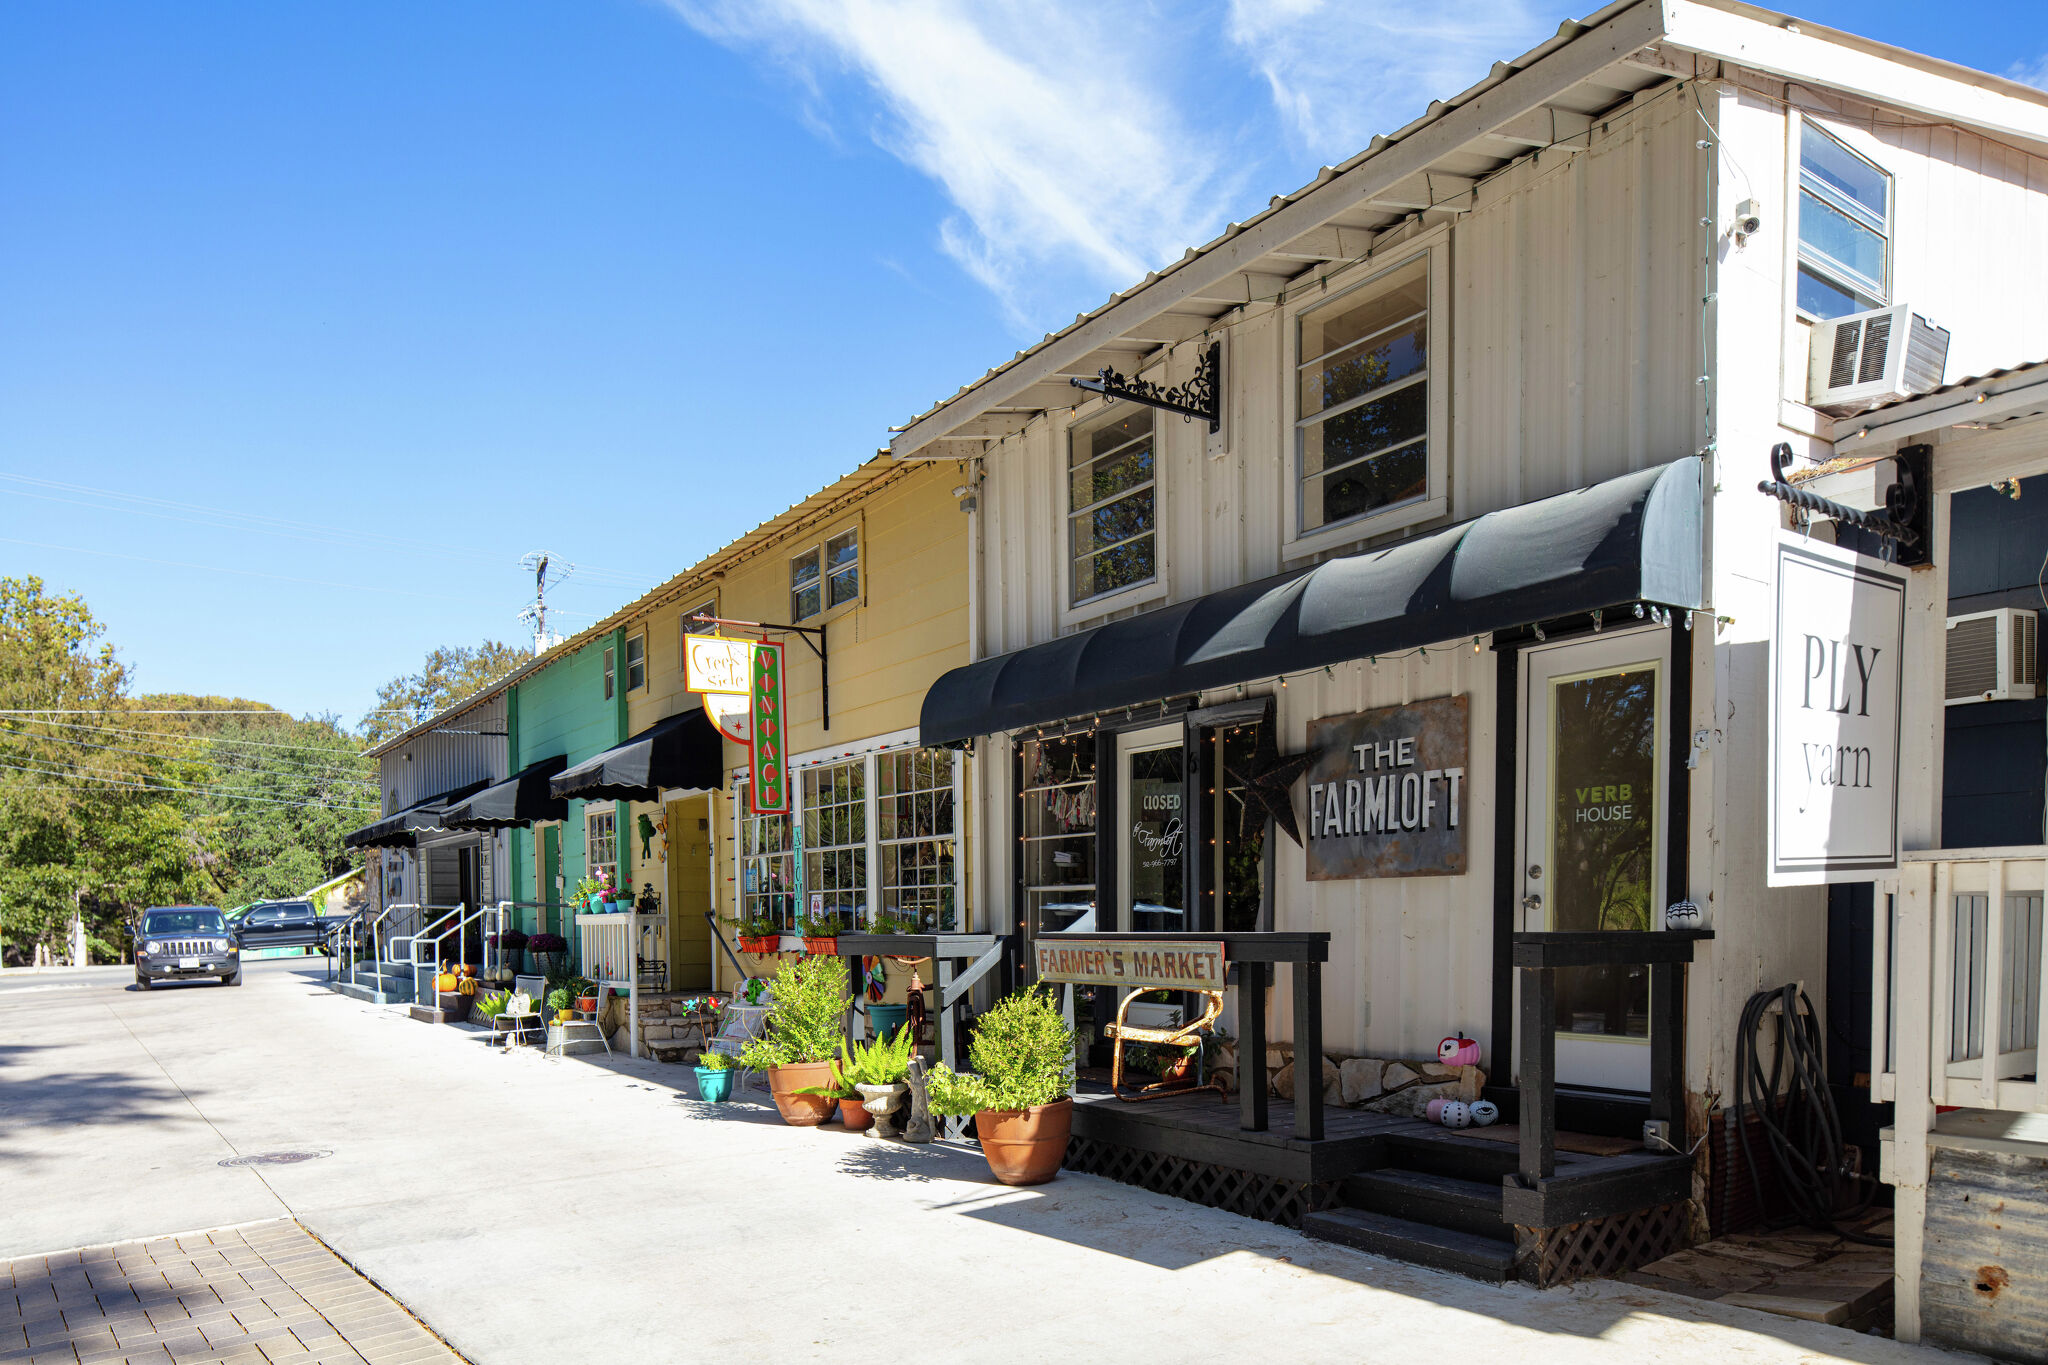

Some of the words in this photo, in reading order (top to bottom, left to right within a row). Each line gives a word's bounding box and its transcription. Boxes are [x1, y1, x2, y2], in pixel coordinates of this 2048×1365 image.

[692, 644, 740, 675] Creek
[1801, 633, 1882, 717] PLY
[708, 664, 744, 687] side
[760, 650, 776, 806] VINTAGE
[1352, 737, 1415, 772] THE
[1799, 742, 1872, 814] yarn
[1143, 794, 1181, 810] CLOSED
[1310, 767, 1464, 838] FARMLOFT
[1575, 784, 1632, 804] VERB
[1575, 805, 1632, 823] HOUSE
[1039, 949, 1125, 976] FARMER'S
[1133, 951, 1217, 980] MARKET
